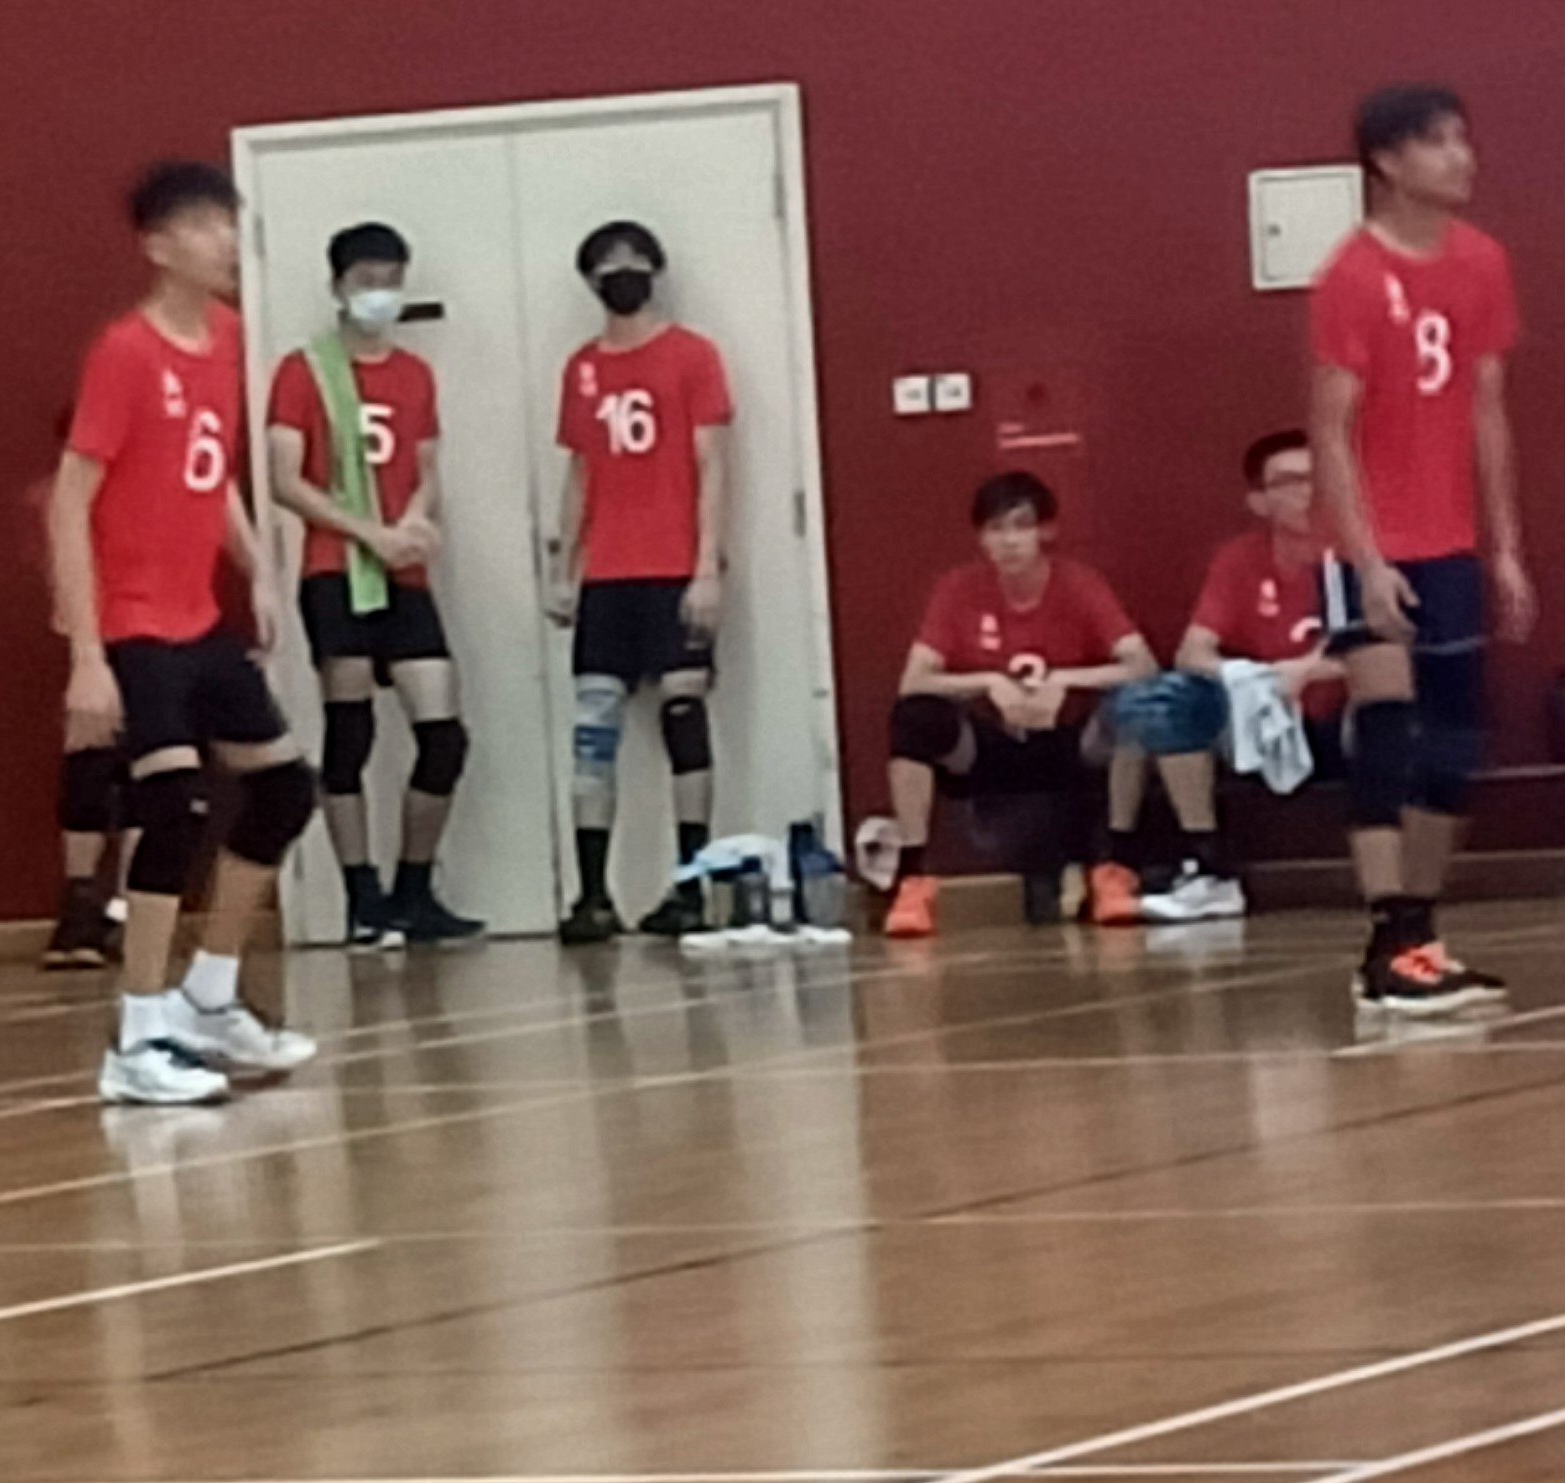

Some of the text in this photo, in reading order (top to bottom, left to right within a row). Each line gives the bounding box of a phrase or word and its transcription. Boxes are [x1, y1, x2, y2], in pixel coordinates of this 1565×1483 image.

[185, 407, 224, 491] 6
[359, 404, 394, 463] 5
[596, 388, 656, 454] 16
